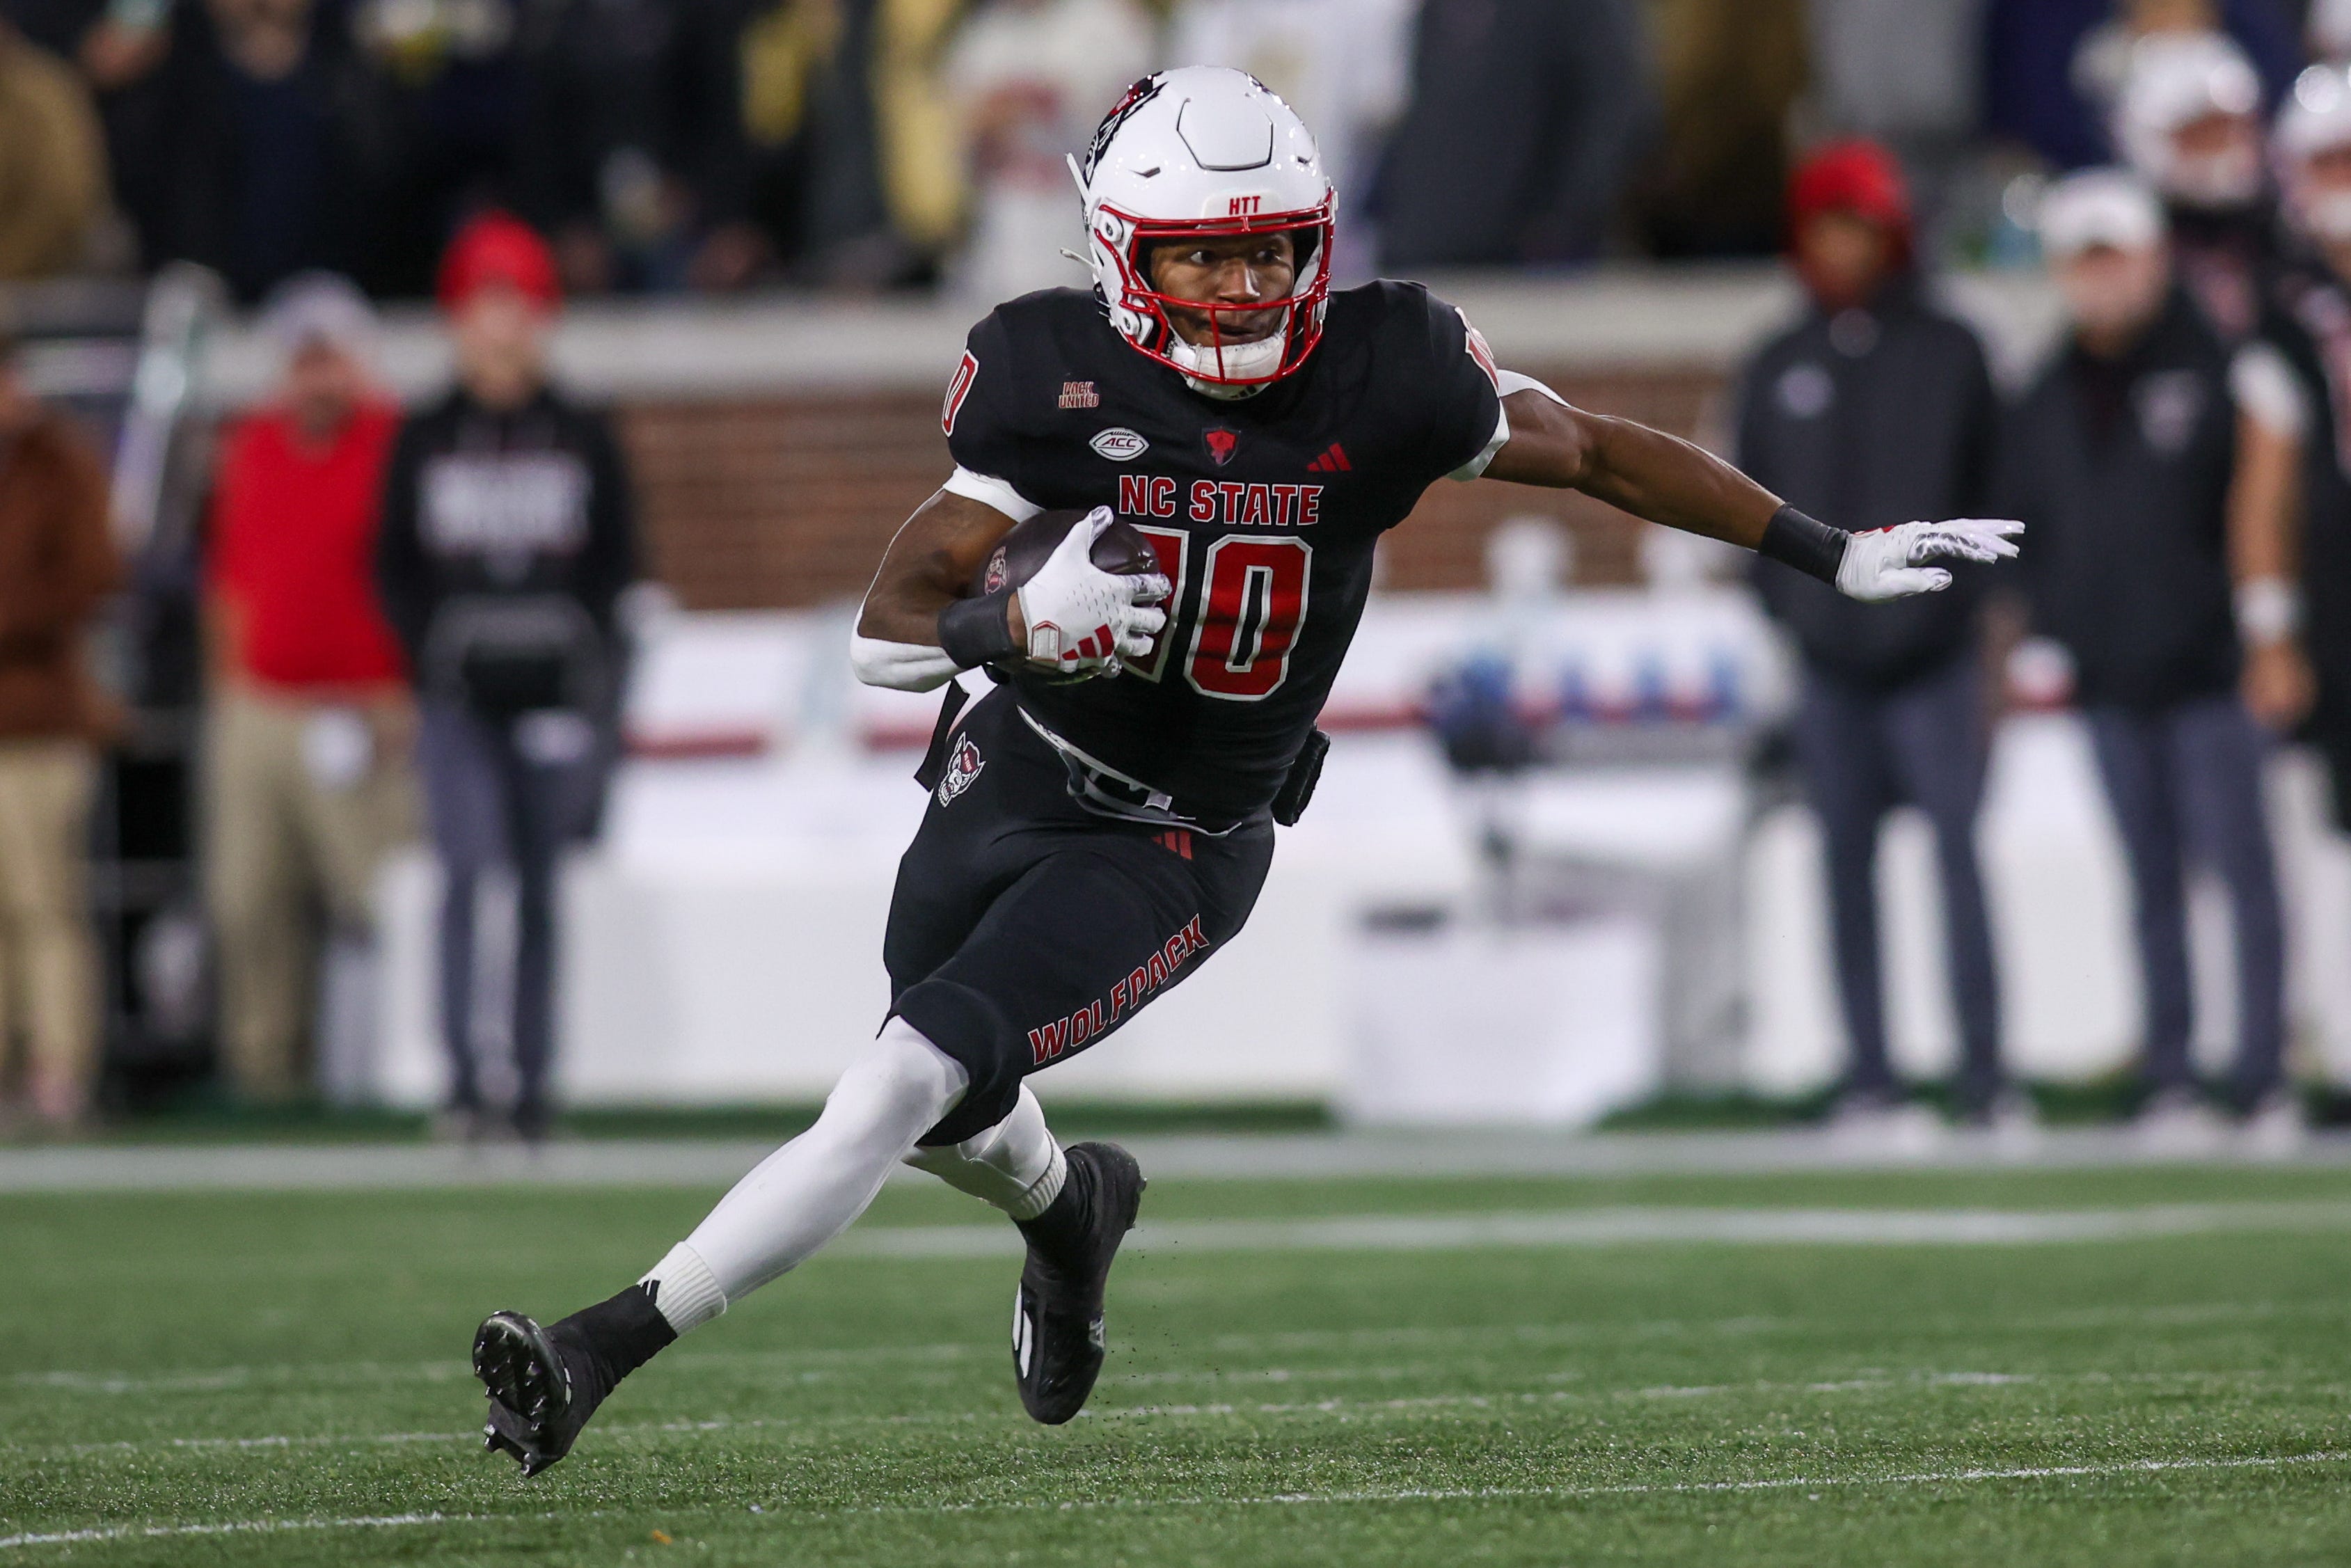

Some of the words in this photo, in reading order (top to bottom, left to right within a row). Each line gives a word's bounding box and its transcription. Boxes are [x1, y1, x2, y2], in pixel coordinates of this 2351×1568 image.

[1229, 196, 1260, 215] HTT
[1063, 381, 1094, 395] PACK
[1058, 393, 1100, 409] UNITED
[1101, 437, 1138, 448] ACC
[1118, 475, 1176, 518] NC
[1189, 480, 1324, 526] STATE
[1027, 912, 1210, 1066] WOLFPACK
